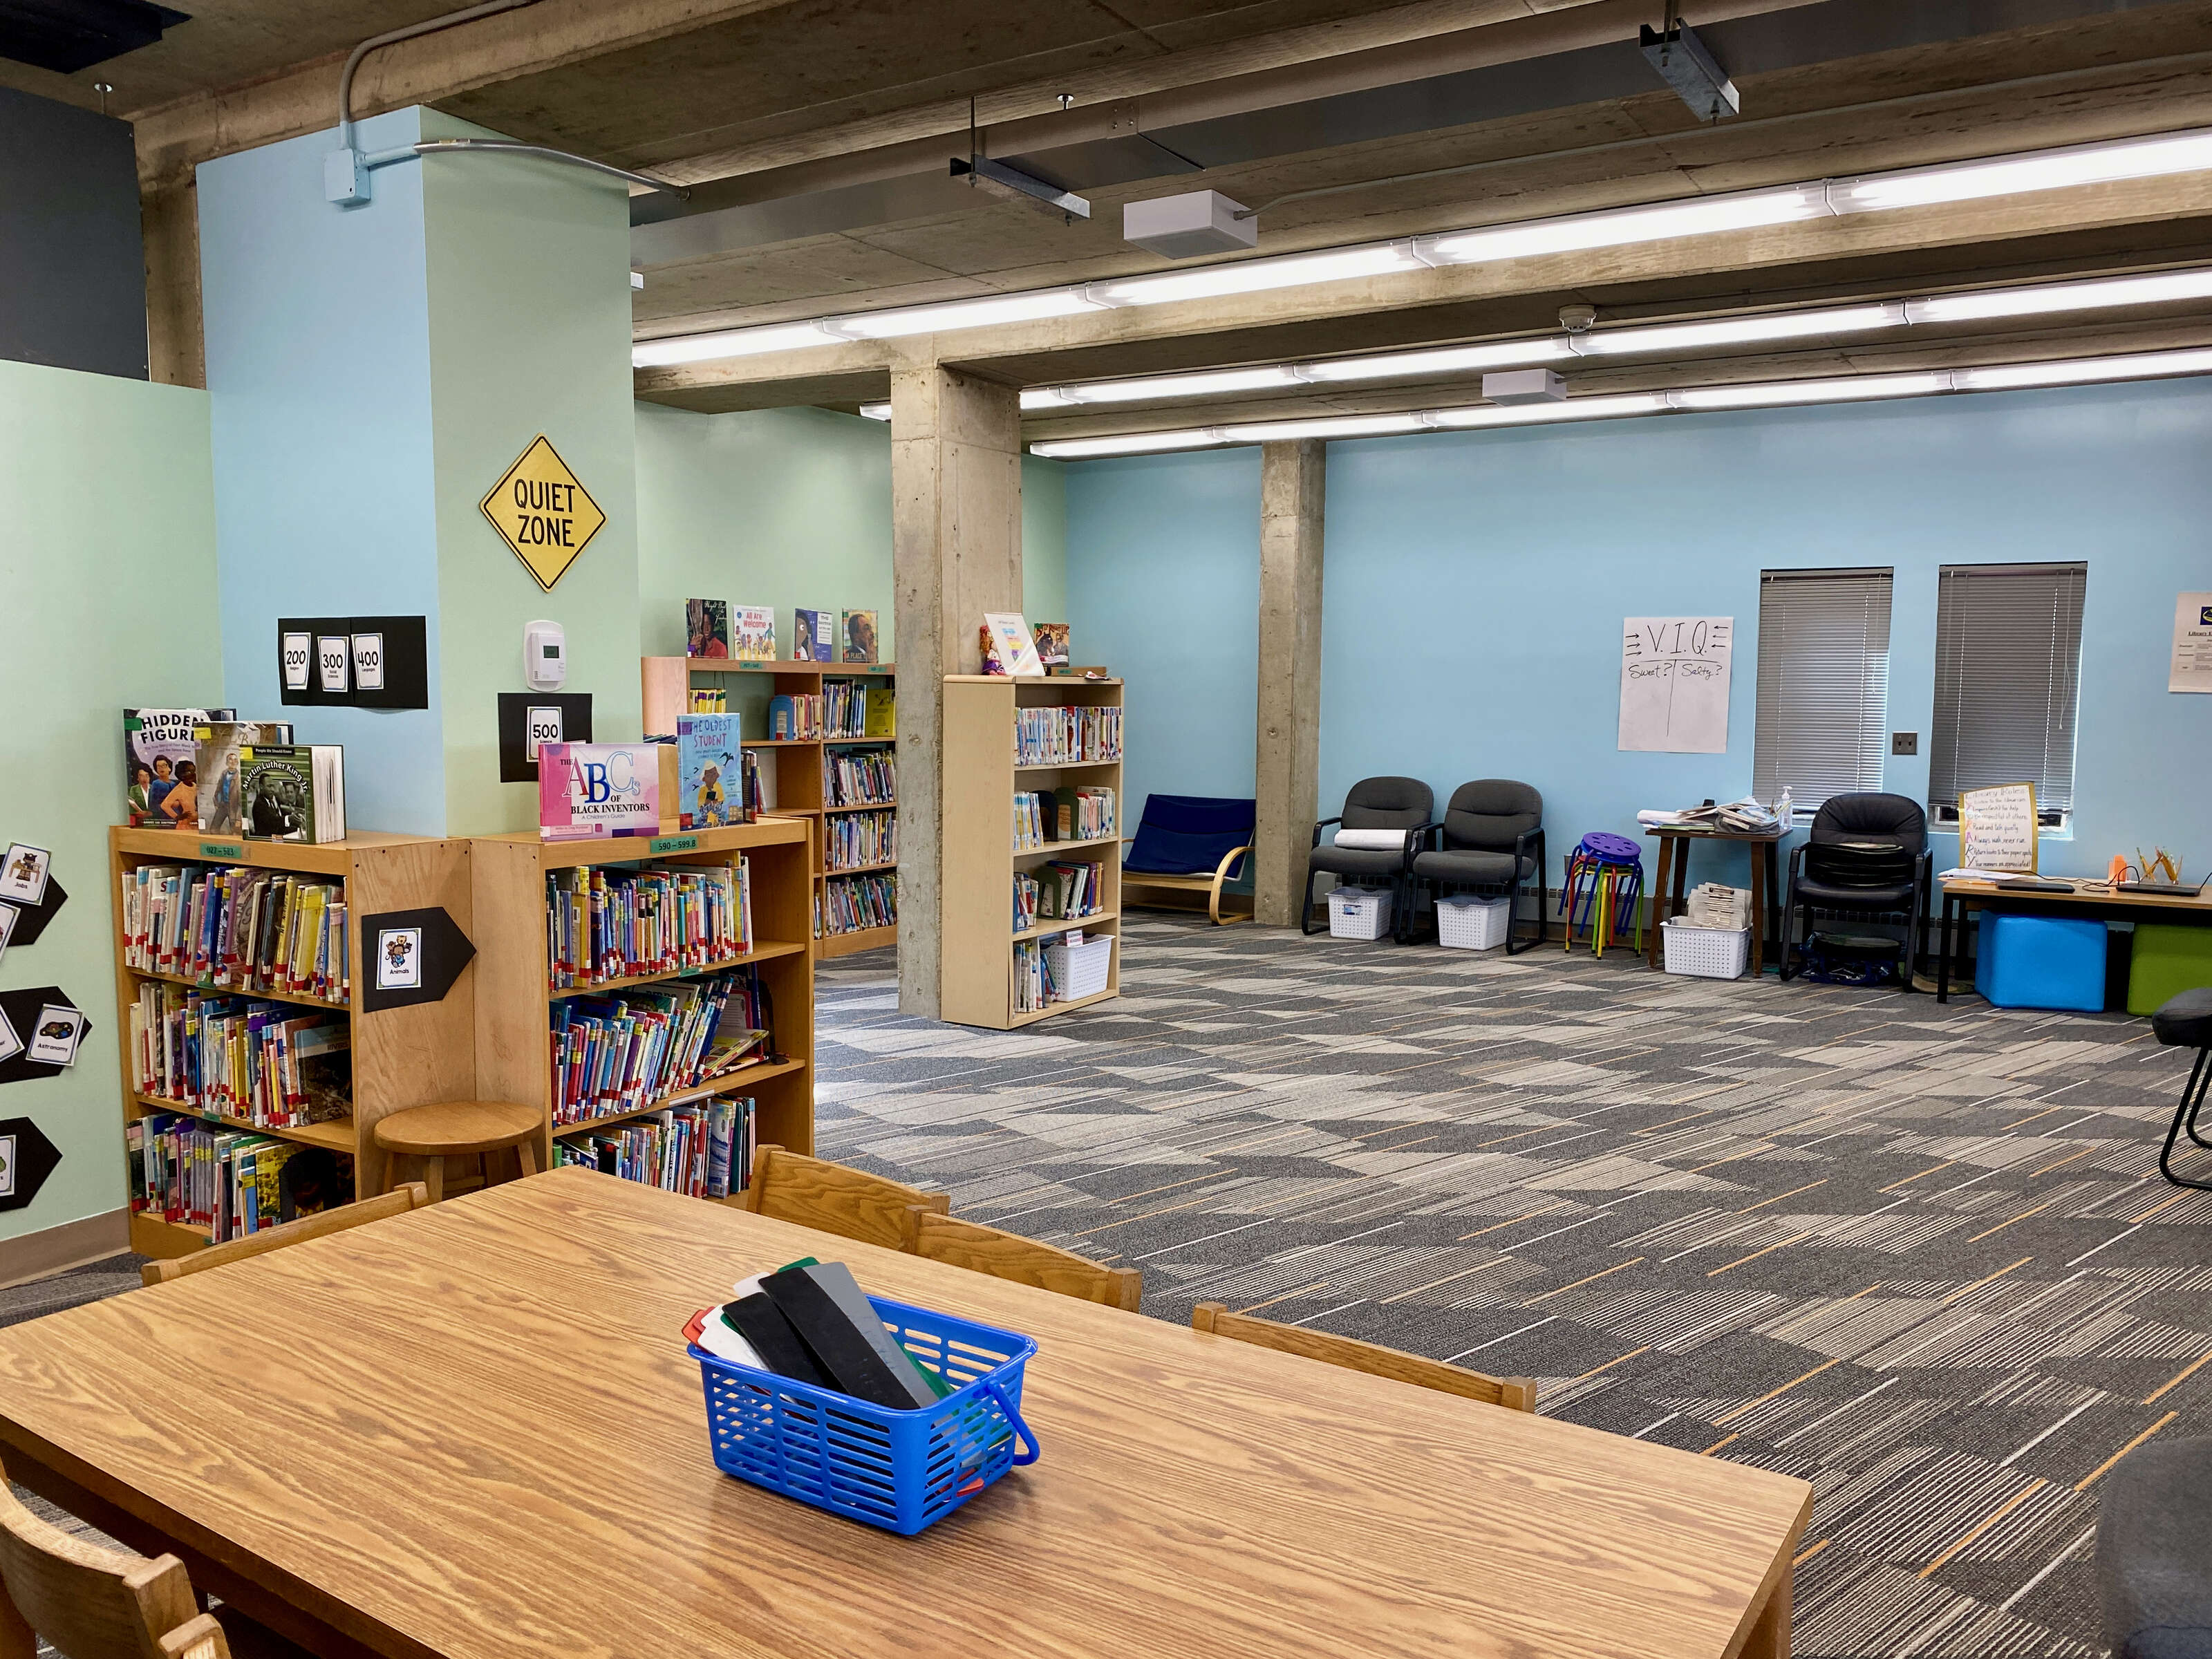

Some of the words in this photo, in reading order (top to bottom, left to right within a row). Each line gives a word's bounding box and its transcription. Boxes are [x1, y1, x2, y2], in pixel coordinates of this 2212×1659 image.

[514, 478, 575, 513] QUIET
[518, 514, 575, 547] ZONE
[743, 620, 767, 628] Welcome
[286, 650, 306, 665] 200
[323, 653, 344, 668] 300
[357, 651, 379, 666] 400
[1629, 663, 1673, 679] Sweet?
[1681, 664, 1723, 680] Salty?
[533, 724, 559, 739] 500
[705, 719, 731, 731] OLDEST
[694, 733, 727, 748] STUDENT
[242, 765, 261, 790] Martin
[261, 760, 285, 770] Luther
[286, 763, 303, 782] King
[301, 780, 309, 792] Jr.
[571, 805, 600, 814] BLACK
[602, 803, 650, 814] INVENTORS
[658, 842, 671, 851] 590
[678, 839, 696, 850] 599.8
[1974, 834, 1991, 845] Always
[37, 1043, 68, 1052] Astronomy
